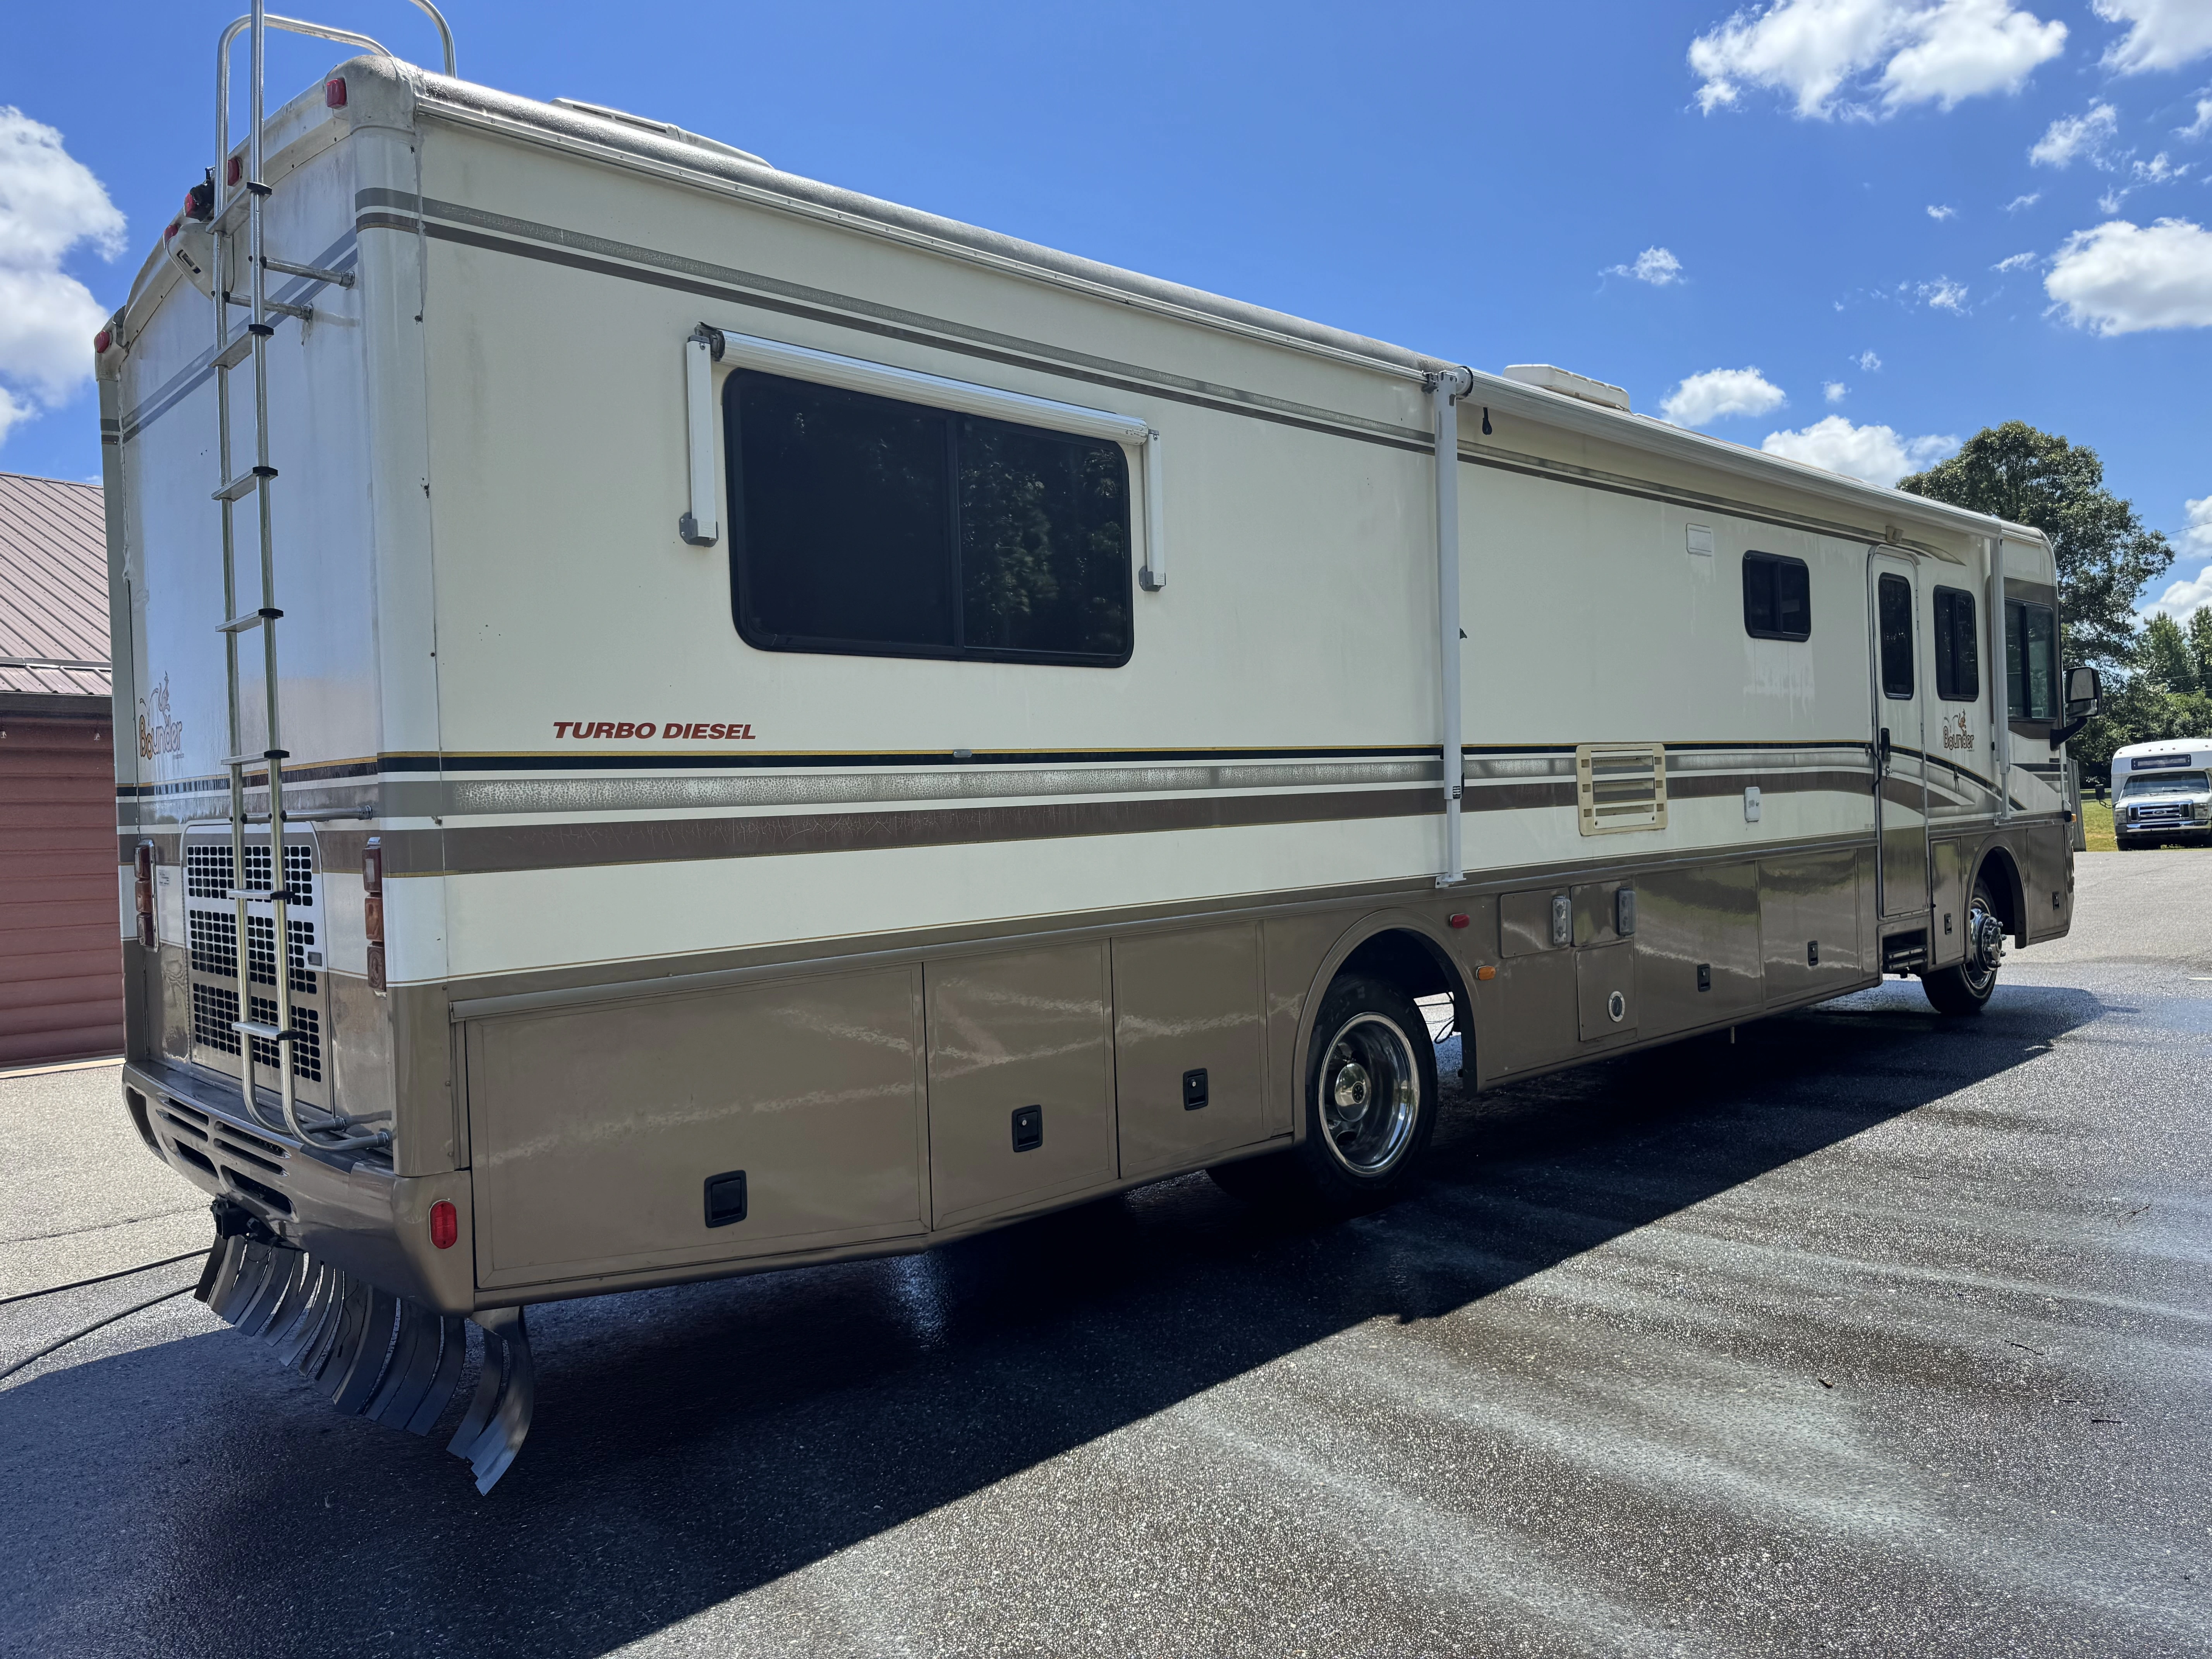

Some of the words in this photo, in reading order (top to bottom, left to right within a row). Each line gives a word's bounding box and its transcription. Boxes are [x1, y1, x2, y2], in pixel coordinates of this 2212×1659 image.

[139, 714, 182, 760] Bounder
[553, 722, 656, 739] TURBO
[662, 723, 756, 739] DIESEL
[1943, 725, 1974, 750] Bounder
